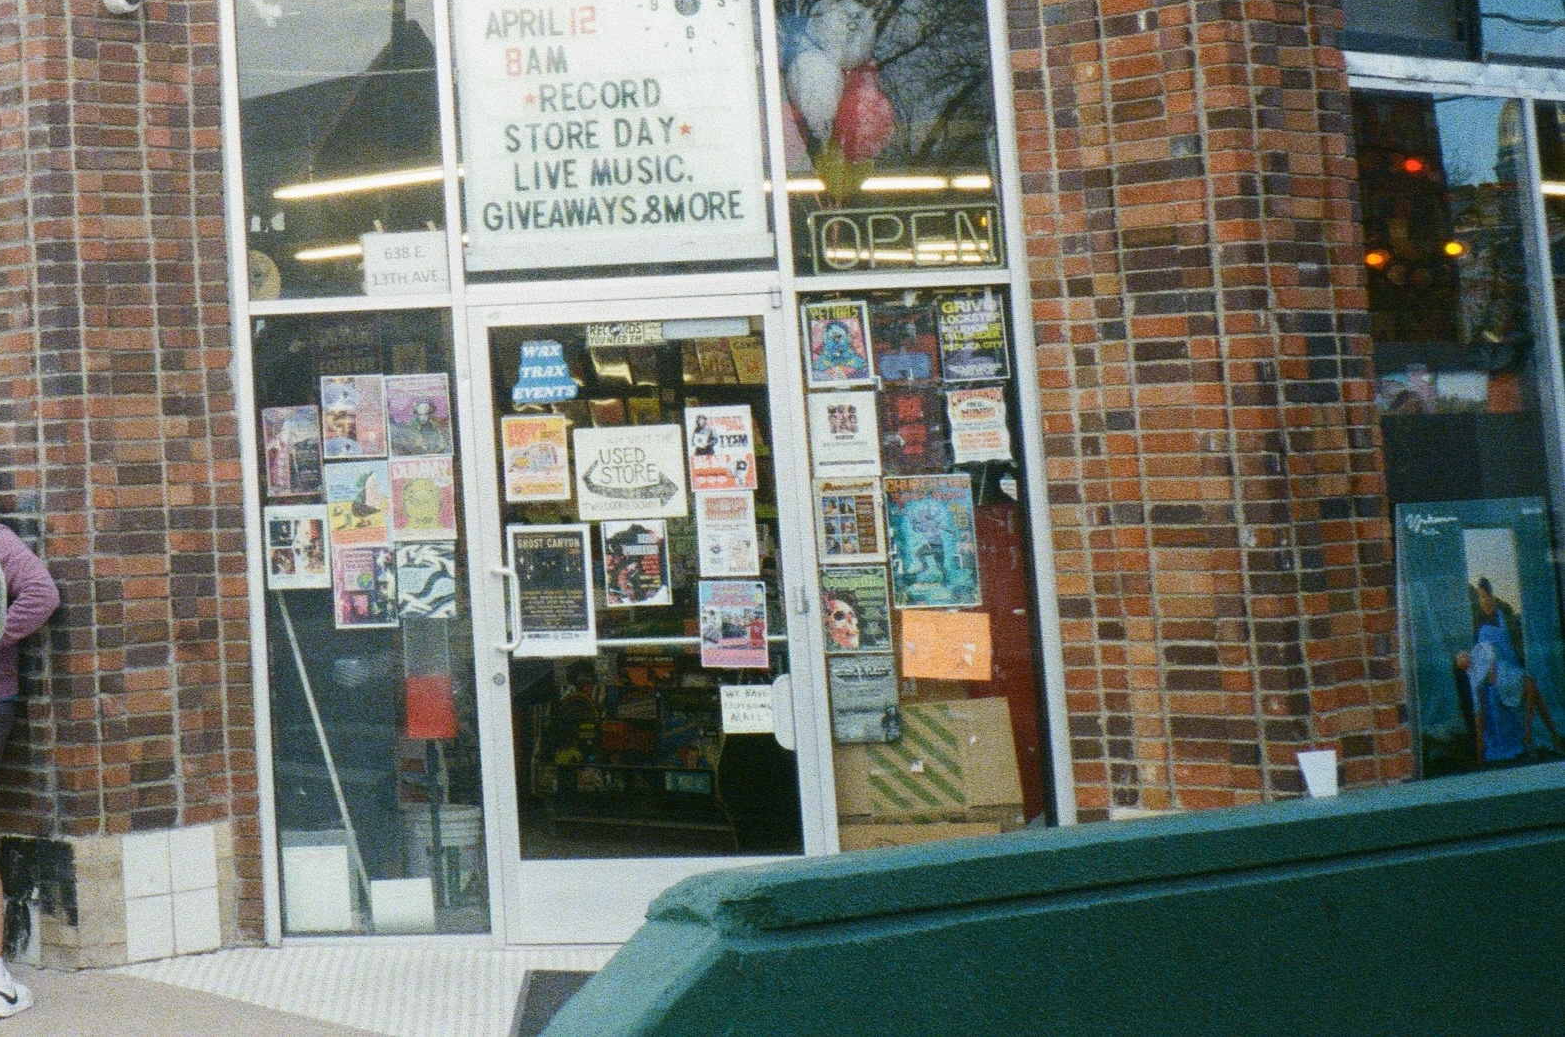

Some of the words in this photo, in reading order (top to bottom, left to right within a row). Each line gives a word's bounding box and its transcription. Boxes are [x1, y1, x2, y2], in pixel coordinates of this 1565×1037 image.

[485, 6, 563, 39] APRIL
[569, 5, 597, 35] 12
[505, 45, 569, 77] 8AM
[539, 77, 661, 112] RECORD
[504, 119, 599, 153] STORE
[613, 116, 674, 148] DAY
[514, 159, 579, 191] LIVE
[821, 209, 995, 270] OPEN
[384, 246, 410, 260] 638
[372, 272, 408, 286] 13TH
[522, 344, 562, 358] WAX
[520, 365, 567, 379] TRAX
[513, 385, 577, 400] EVENTS
[719, 435, 749, 448] TYSM
[599, 447, 646, 465] USED
[601, 463, 658, 484] STORE
[515, 539, 542, 550] GHOST
[546, 538, 580, 548] CANYON
